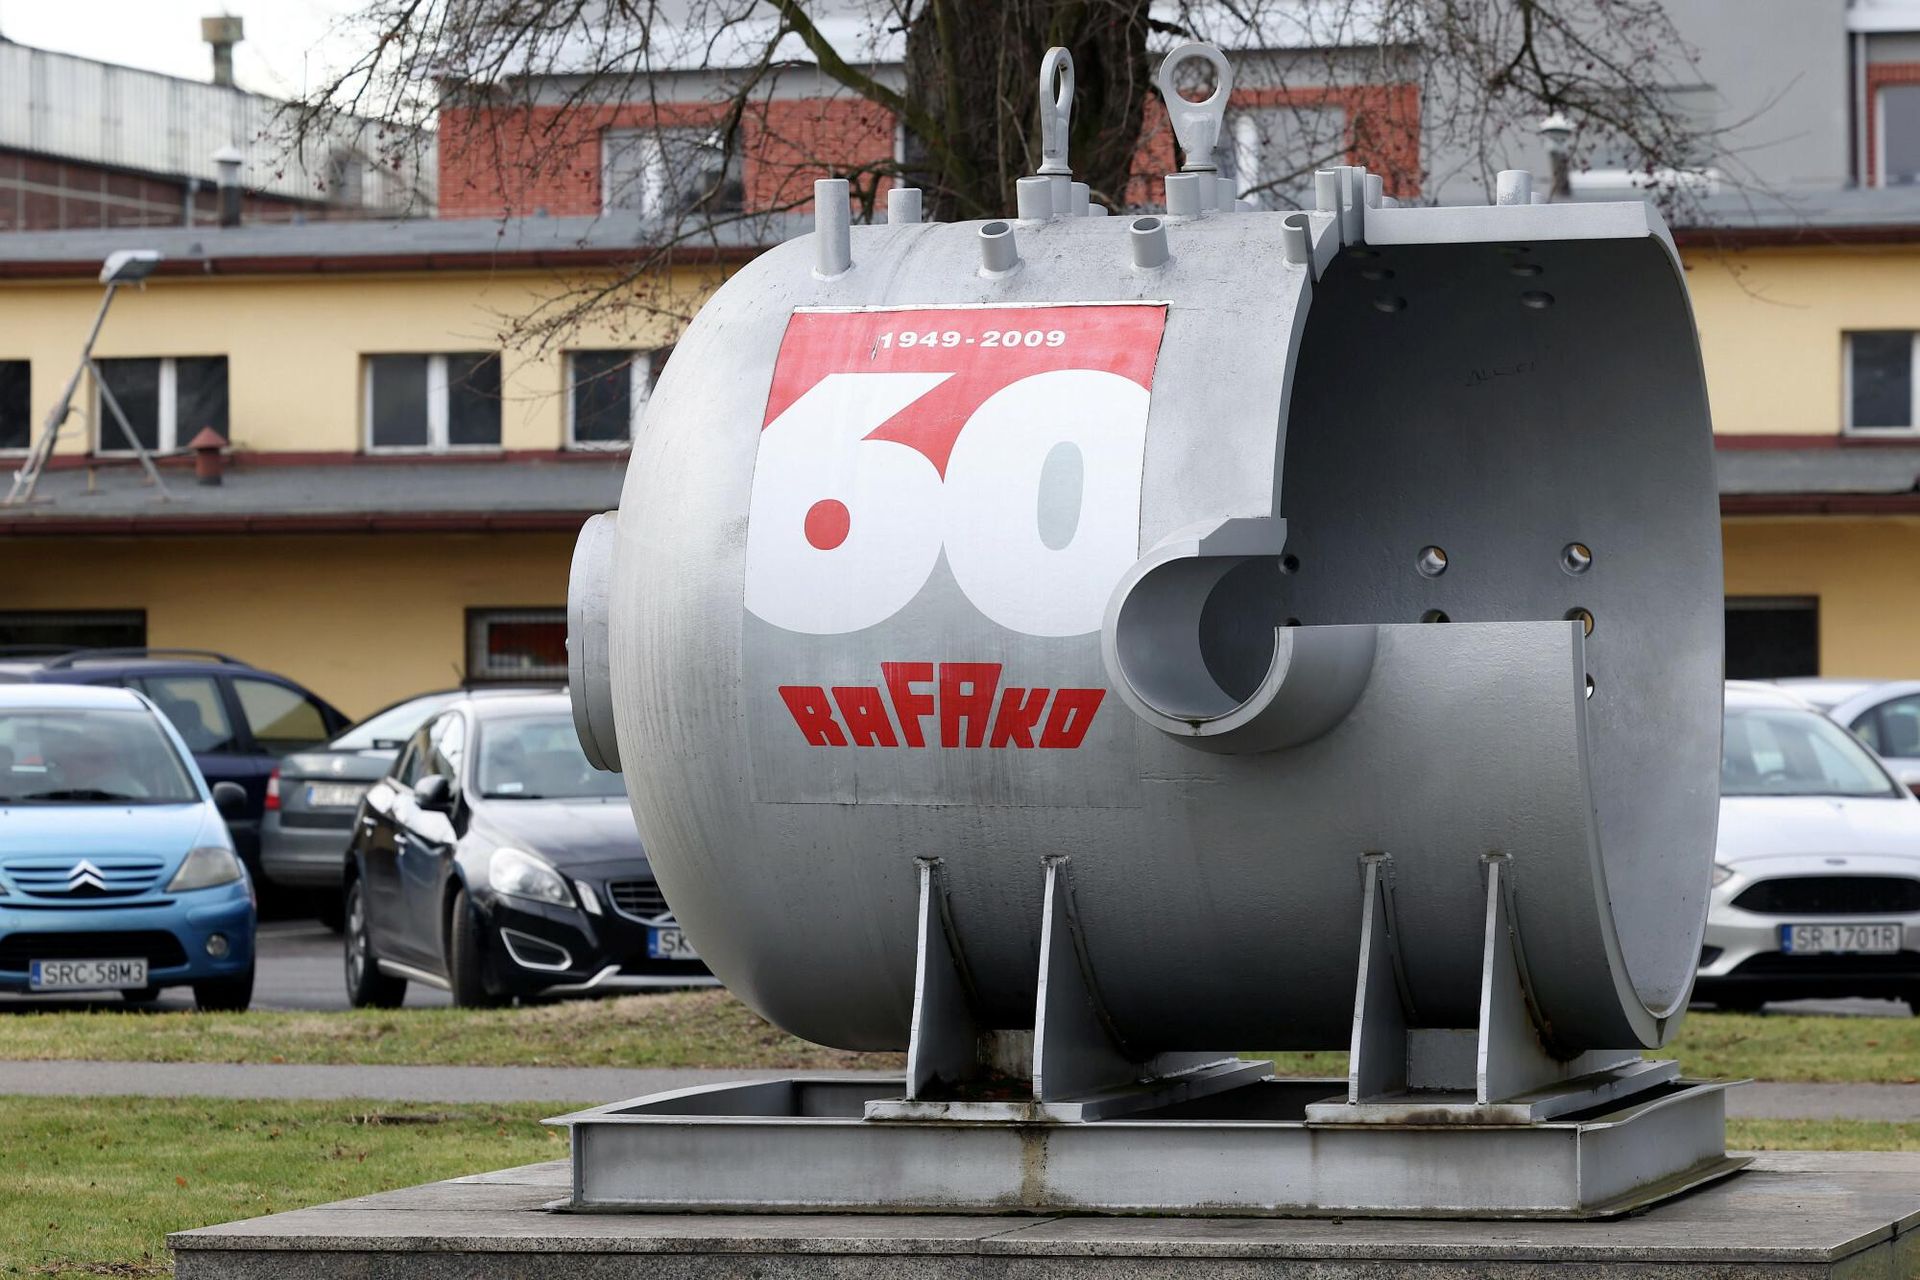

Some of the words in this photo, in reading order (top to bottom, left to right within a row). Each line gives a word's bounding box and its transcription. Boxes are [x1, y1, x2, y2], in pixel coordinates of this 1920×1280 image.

[744, 369, 1151, 637] 60
[778, 662, 1106, 748] RAFAKO
[1796, 928, 1824, 949] SR
[1833, 928, 1896, 950] 1701R
[44, 963, 87, 984] SRC
[95, 963, 143, 983] 58M3
